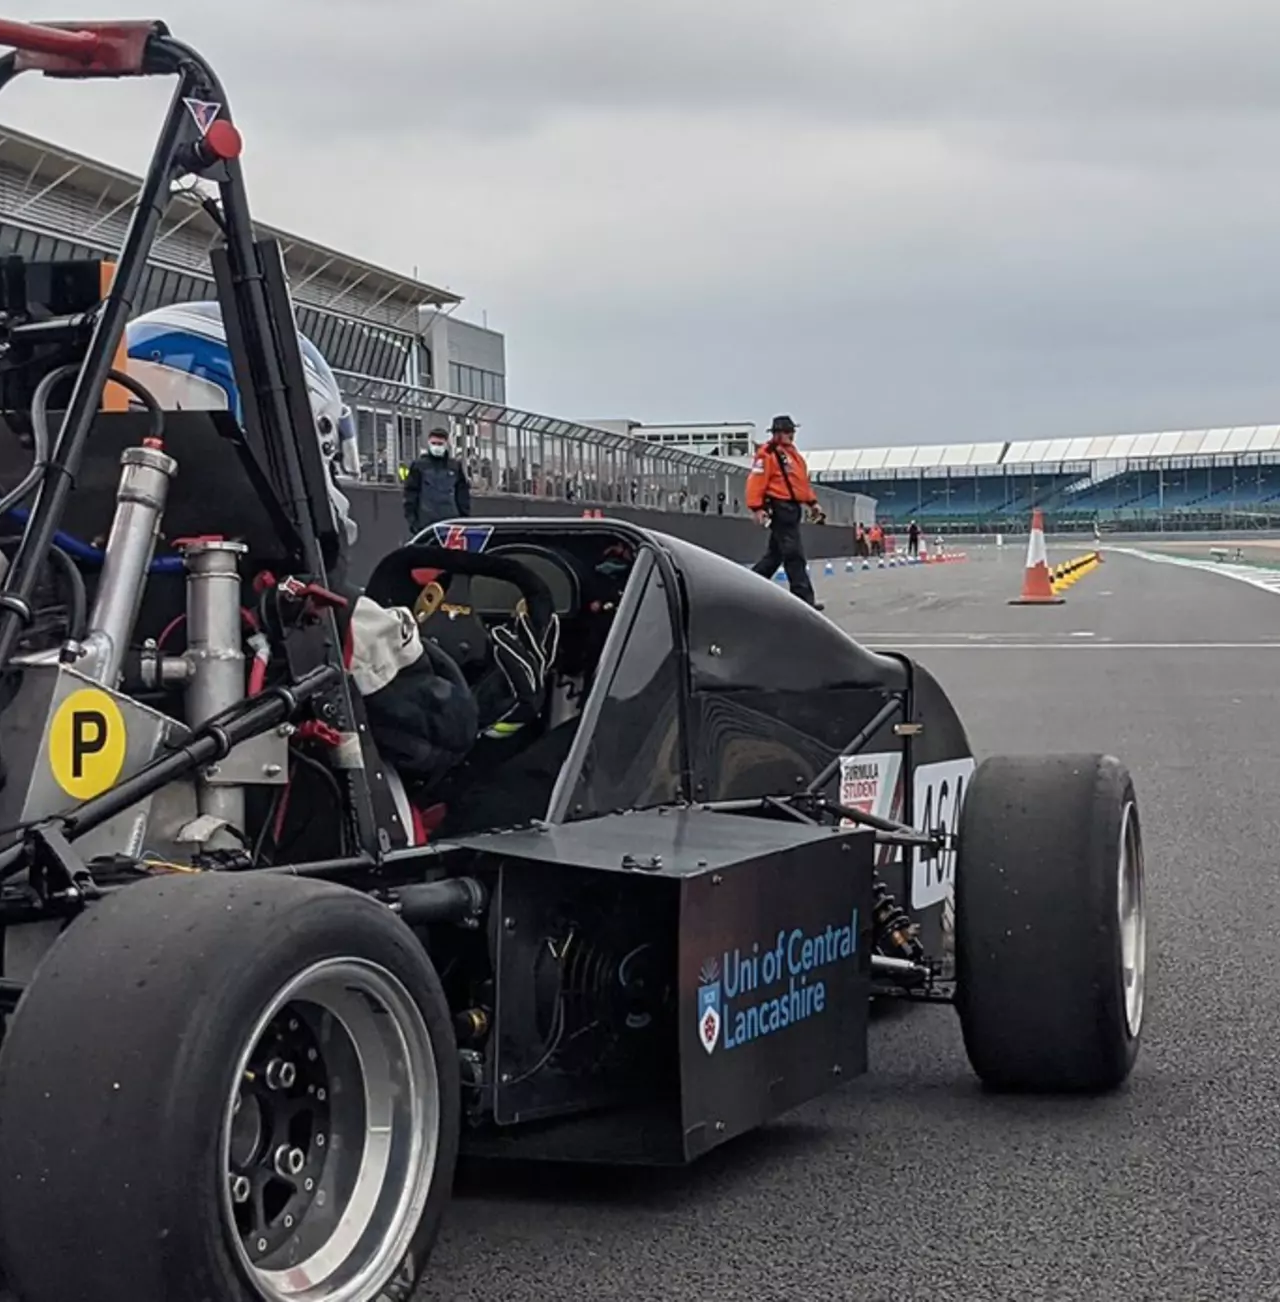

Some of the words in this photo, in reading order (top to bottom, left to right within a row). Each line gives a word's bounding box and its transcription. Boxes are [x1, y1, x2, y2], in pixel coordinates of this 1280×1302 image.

[72, 711, 107, 777] P
[844, 781, 877, 799] STUDENT
[724, 943, 758, 998] Uni
[762, 930, 784, 984] of
[787, 908, 858, 975] Central
[724, 976, 825, 1049] Lancashire
